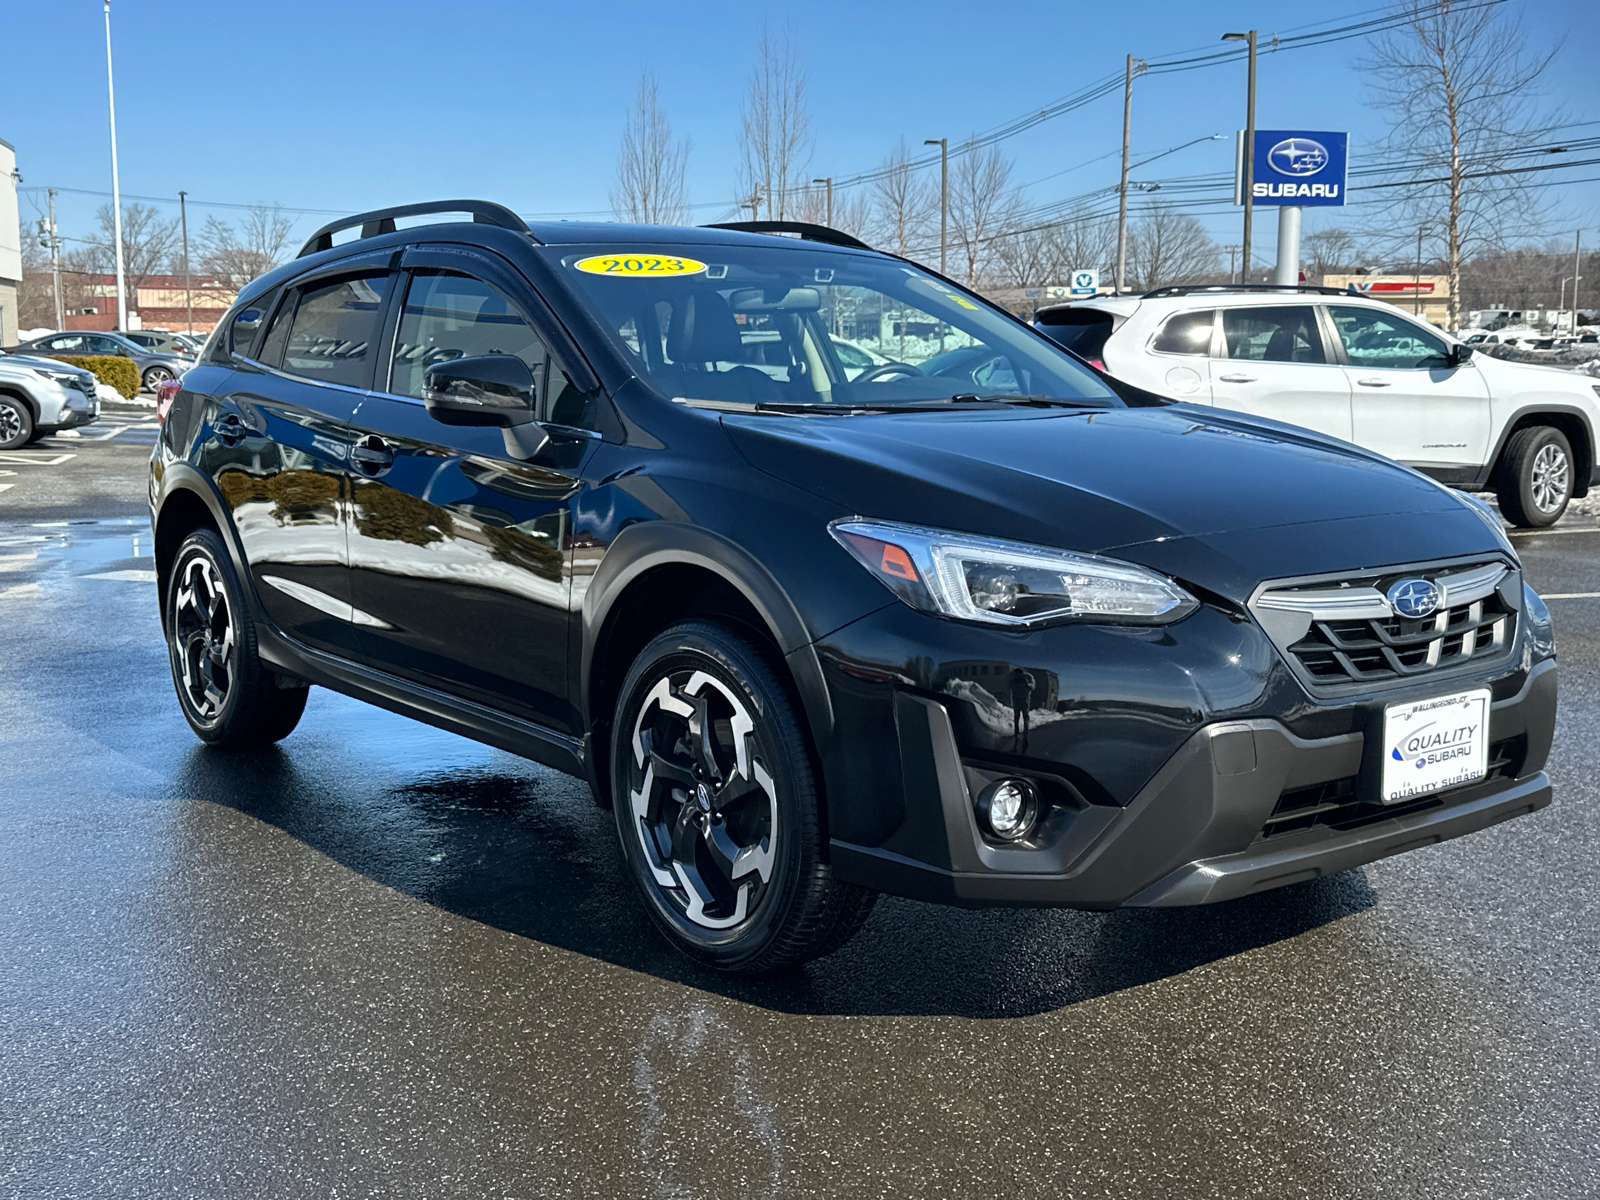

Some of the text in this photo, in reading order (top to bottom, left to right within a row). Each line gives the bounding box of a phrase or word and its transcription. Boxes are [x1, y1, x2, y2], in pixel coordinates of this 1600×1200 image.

[1253, 183, 1338, 198] SUBARU
[602, 259, 685, 272] 2023
[1407, 724, 1478, 752] QUALITY
[1427, 745, 1472, 765] SUBARU
[1390, 769, 1484, 801] QUALITY SUBARU
